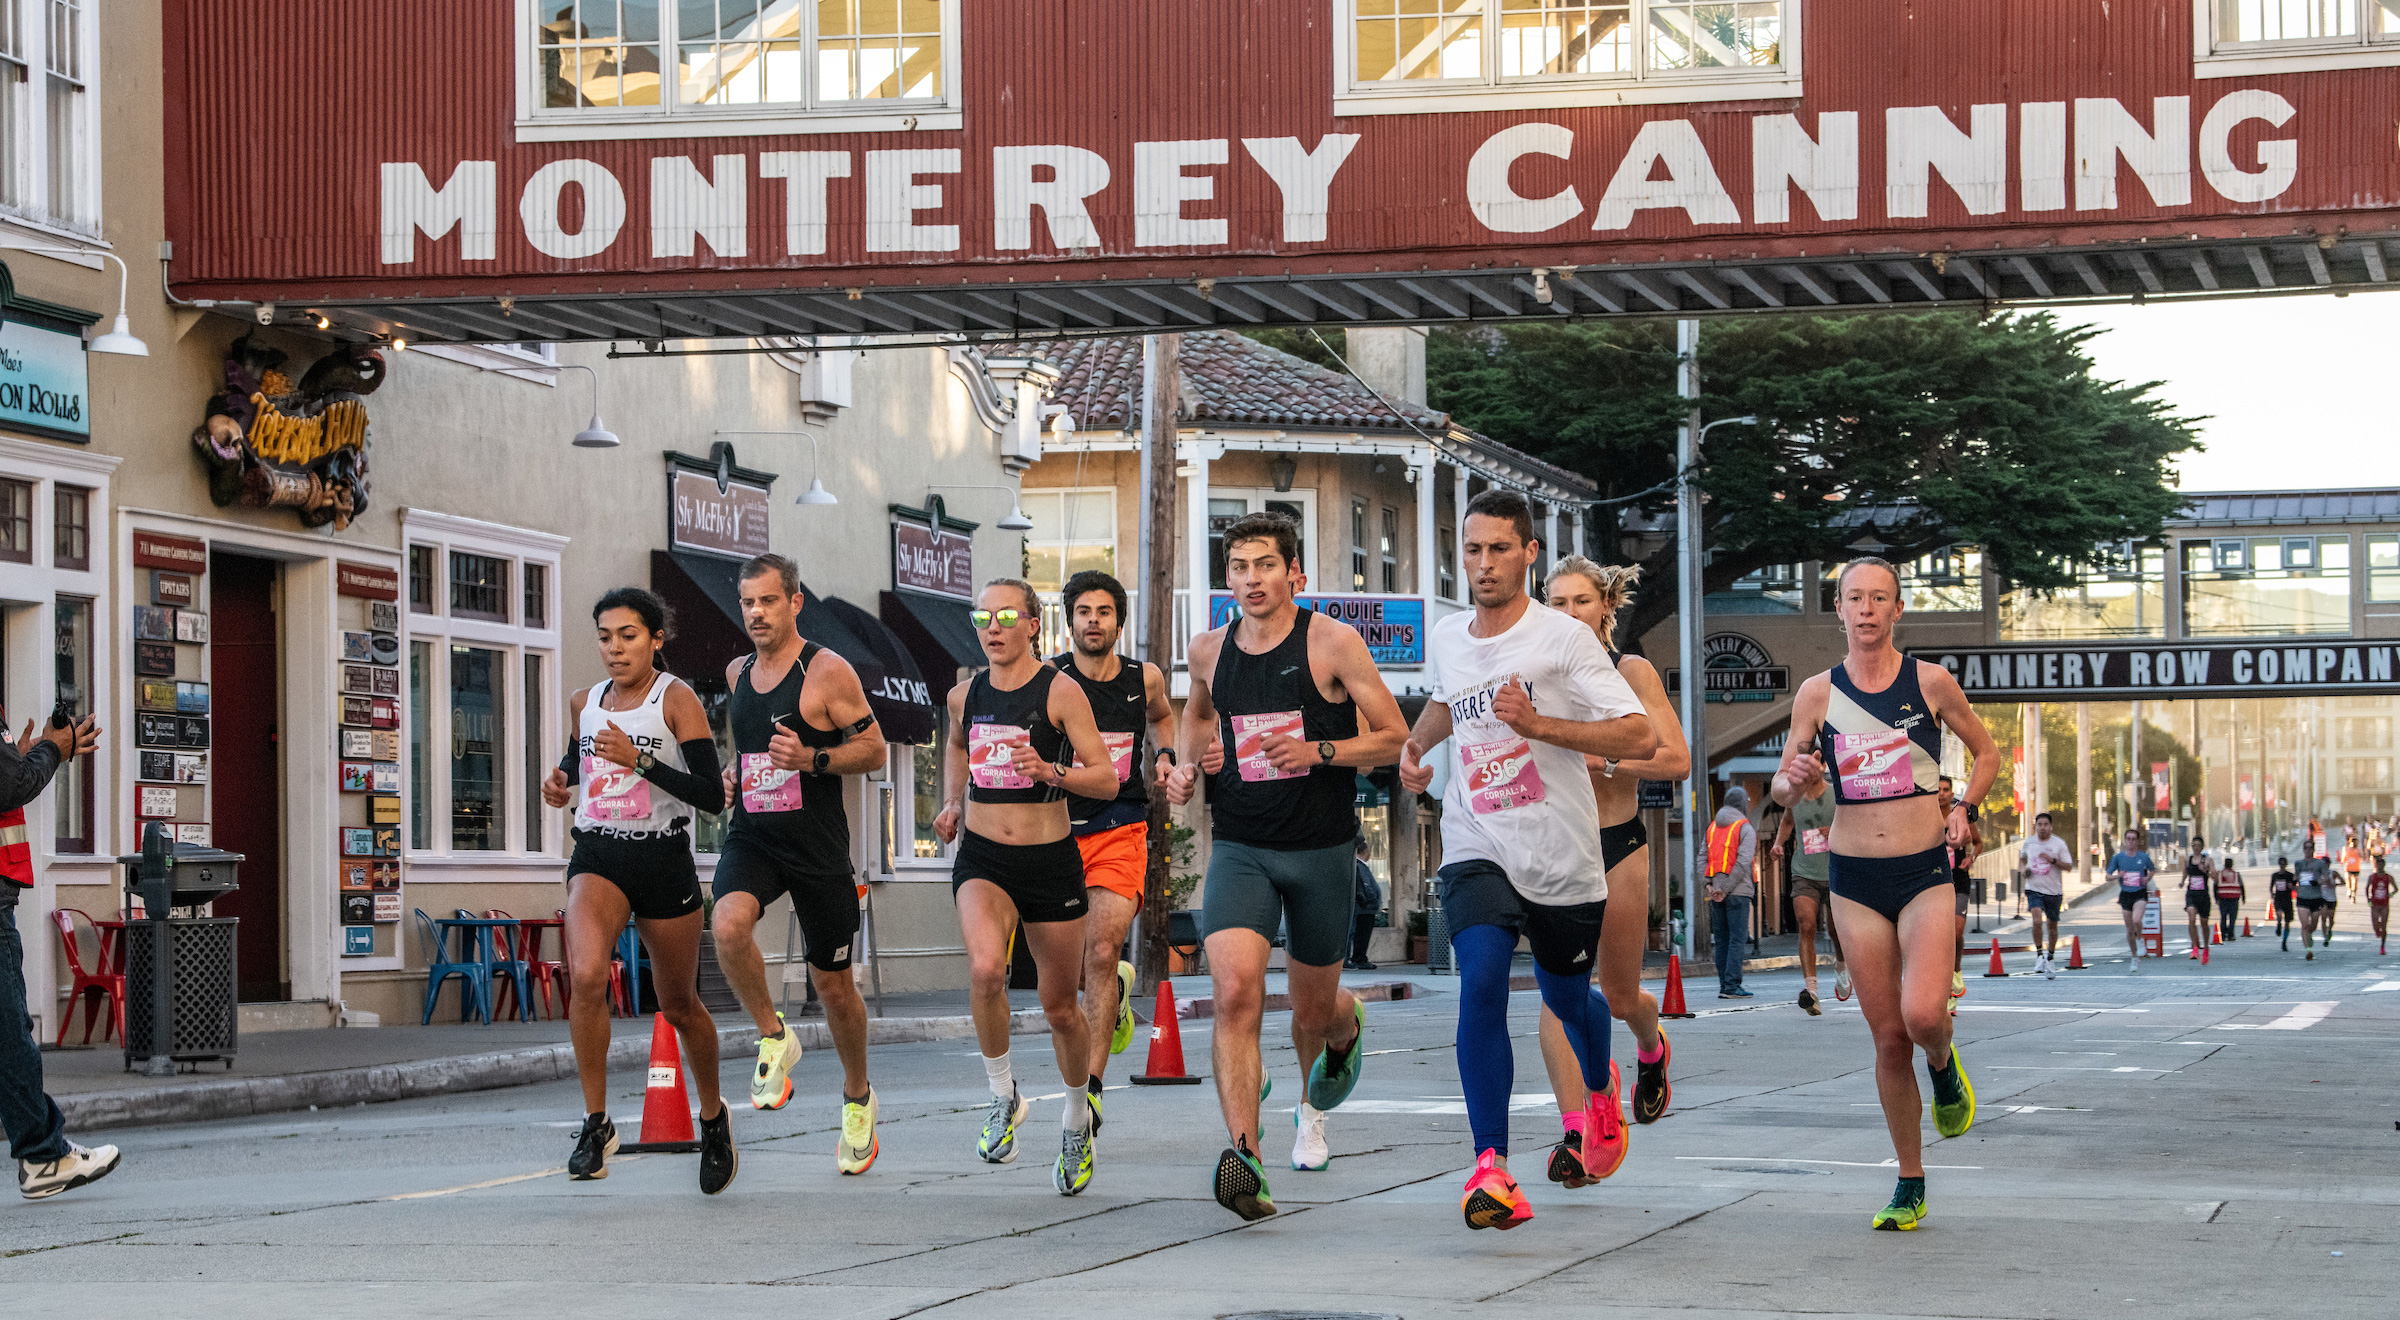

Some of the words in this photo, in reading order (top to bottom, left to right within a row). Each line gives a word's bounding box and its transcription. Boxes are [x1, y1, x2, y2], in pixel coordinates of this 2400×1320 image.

[380, 133, 1361, 265] MONTEREY
[1466, 89, 2298, 233] CANNING
[28, 383, 80, 422] ROLLS
[677, 495, 693, 534] Sly
[694, 498, 732, 540] McFly's
[899, 543, 912, 578] Sly
[912, 546, 943, 584] McFly's
[159, 581, 190, 597] UPSTAIRS
[1311, 600, 1384, 622] LOUIE
[1379, 650, 1414, 660] PIZZA
[1704, 637, 1742, 658] NNERY
[1740, 643, 1766, 667] ROW
[2130, 650, 2211, 686] ROW
[2232, 646, 2400, 684] COMPAN
[1704, 673, 1751, 688] TEREY,
[1755, 672, 1776, 688] CA.
[1462, 684, 1480, 696] STATE
[1450, 687, 1495, 724] NTEREY
[1257, 713, 1289, 721] MONTEREY
[1258, 720, 1274, 729] BAY
[985, 742, 1009, 761] 28
[1483, 740, 1512, 750] MONTEREY
[1857, 749, 1887, 771] 25
[750, 768, 786, 787] 360
[981, 768, 1010, 776] CORRAL:
[1477, 758, 1520, 784] 396
[601, 773, 625, 793] 27
[1853, 778, 1890, 787] CORRAL:
[1890, 776, 1898, 784] A
[751, 793, 781, 801] CORRAL:
[782, 792, 788, 800] A
[1484, 787, 1519, 800] CORRAL:
[1520, 784, 1527, 793] A
[597, 800, 629, 808] CORRAL:
